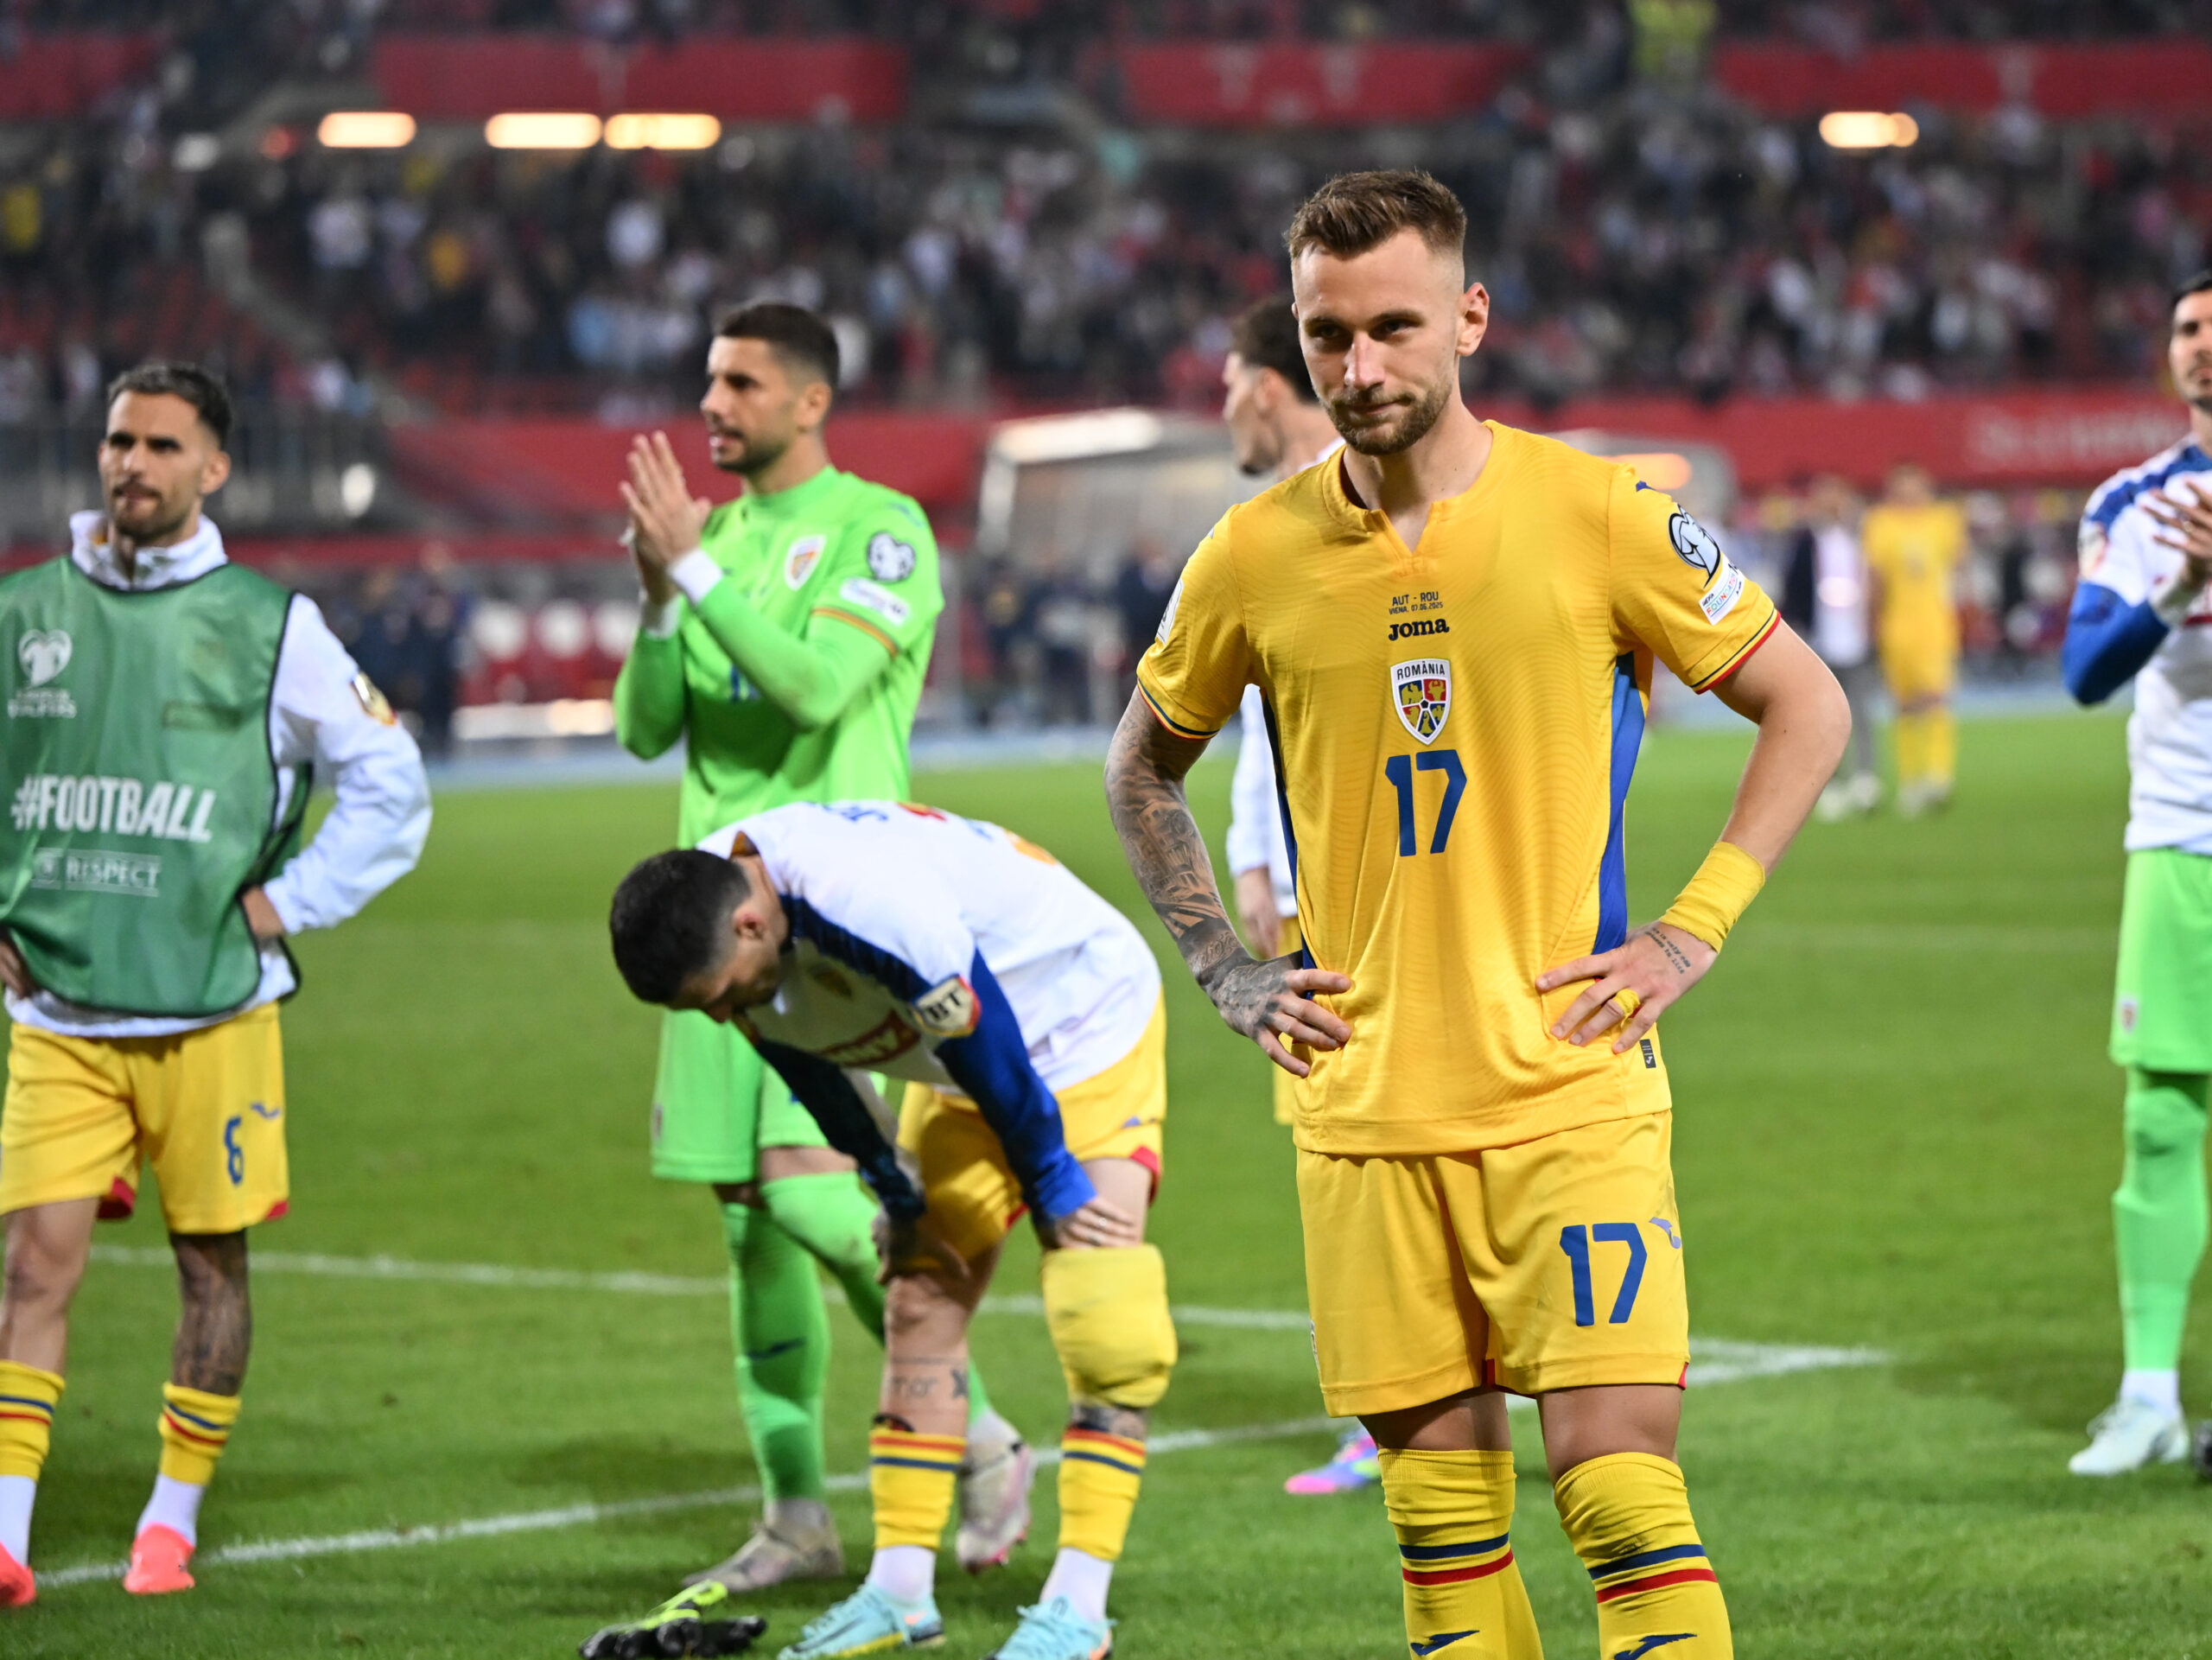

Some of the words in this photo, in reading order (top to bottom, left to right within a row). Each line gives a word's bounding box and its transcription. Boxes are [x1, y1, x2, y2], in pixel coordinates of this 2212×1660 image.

[1392, 595, 1409, 607] AUT
[1420, 591, 1439, 602] ROU
[1396, 660, 1446, 680] ROMÂNIA
[11, 774, 215, 843] #FOOTBALL
[1384, 749, 1467, 857] 17
[66, 855, 159, 887] RESPECT
[224, 1116, 244, 1186] 6
[1559, 1222, 1648, 1326] 17
